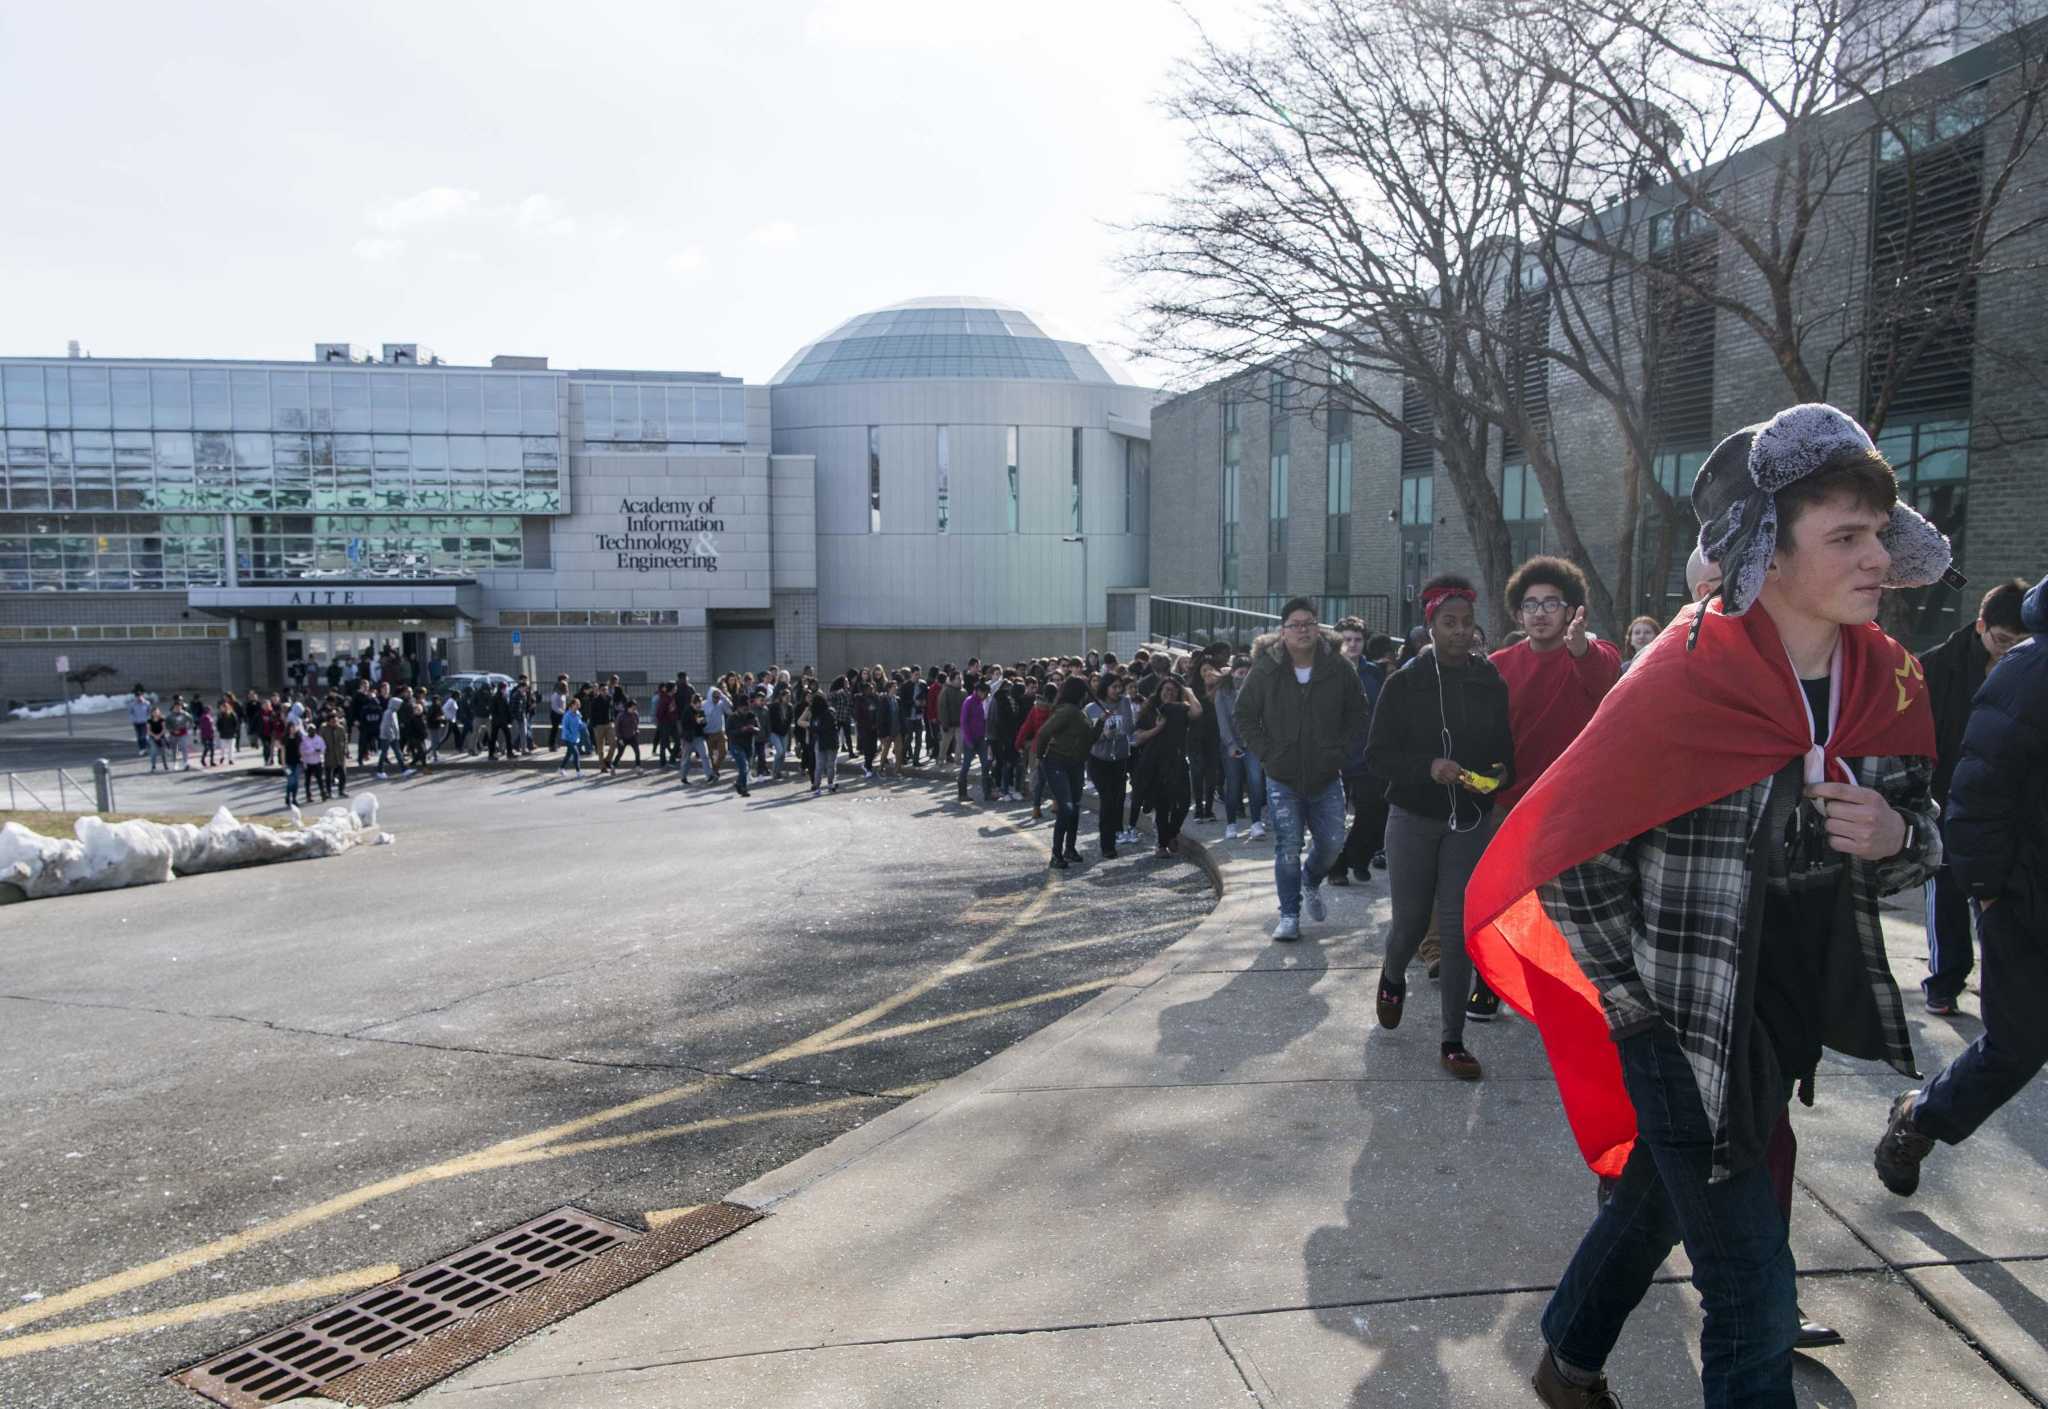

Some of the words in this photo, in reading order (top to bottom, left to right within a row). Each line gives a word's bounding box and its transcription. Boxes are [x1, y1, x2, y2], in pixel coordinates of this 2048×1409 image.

[619, 496, 694, 517] Academy
[698, 496, 716, 514] of
[627, 515, 724, 532] Information
[596, 533, 692, 554] Technology
[695, 532, 719, 556] &
[617, 552, 718, 573] Engineering
[290, 591, 355, 605] AITE
